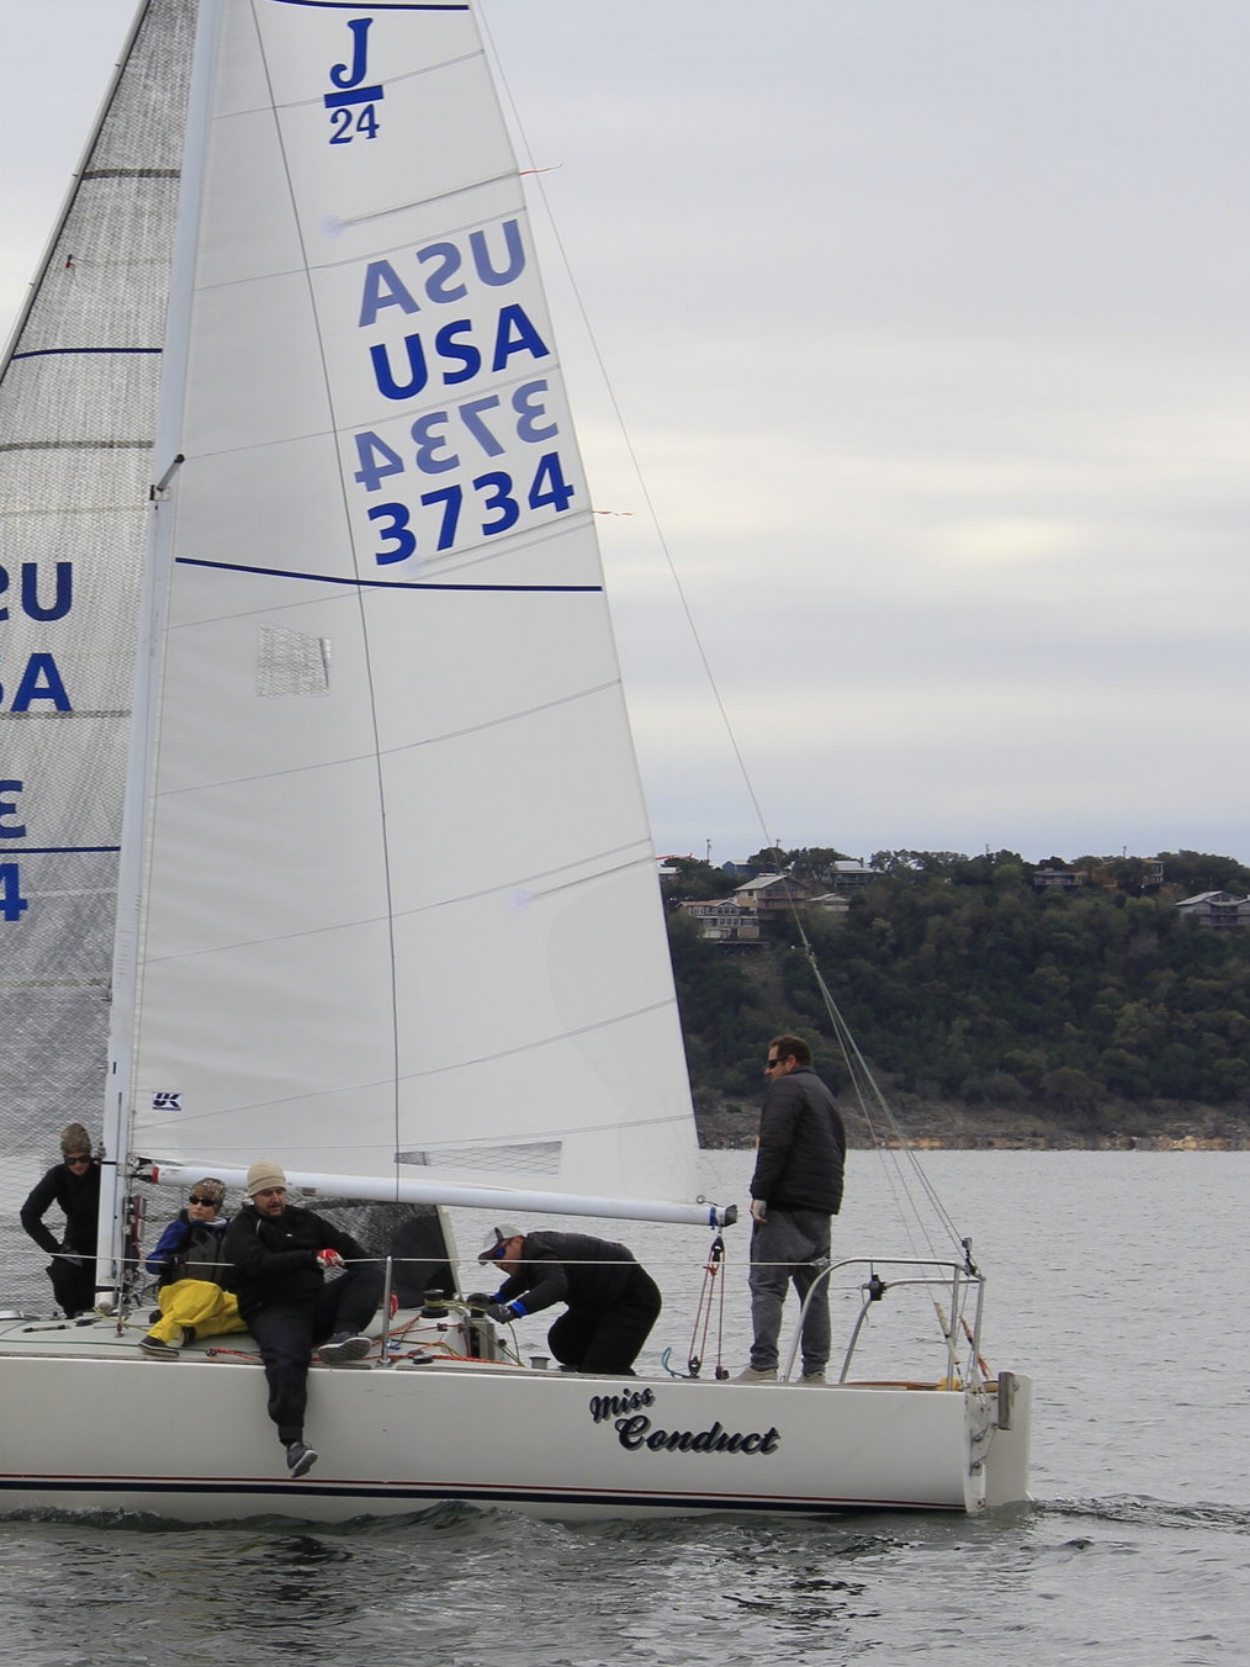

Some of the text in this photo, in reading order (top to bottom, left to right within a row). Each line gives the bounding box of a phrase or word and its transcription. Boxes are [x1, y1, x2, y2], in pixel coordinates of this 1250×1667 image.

[329, 17, 374, 89] J
[329, 104, 380, 145] 24
[369, 303, 550, 400] USA
[367, 451, 575, 566] 3734
[614, 1414, 781, 1455] Conduct
